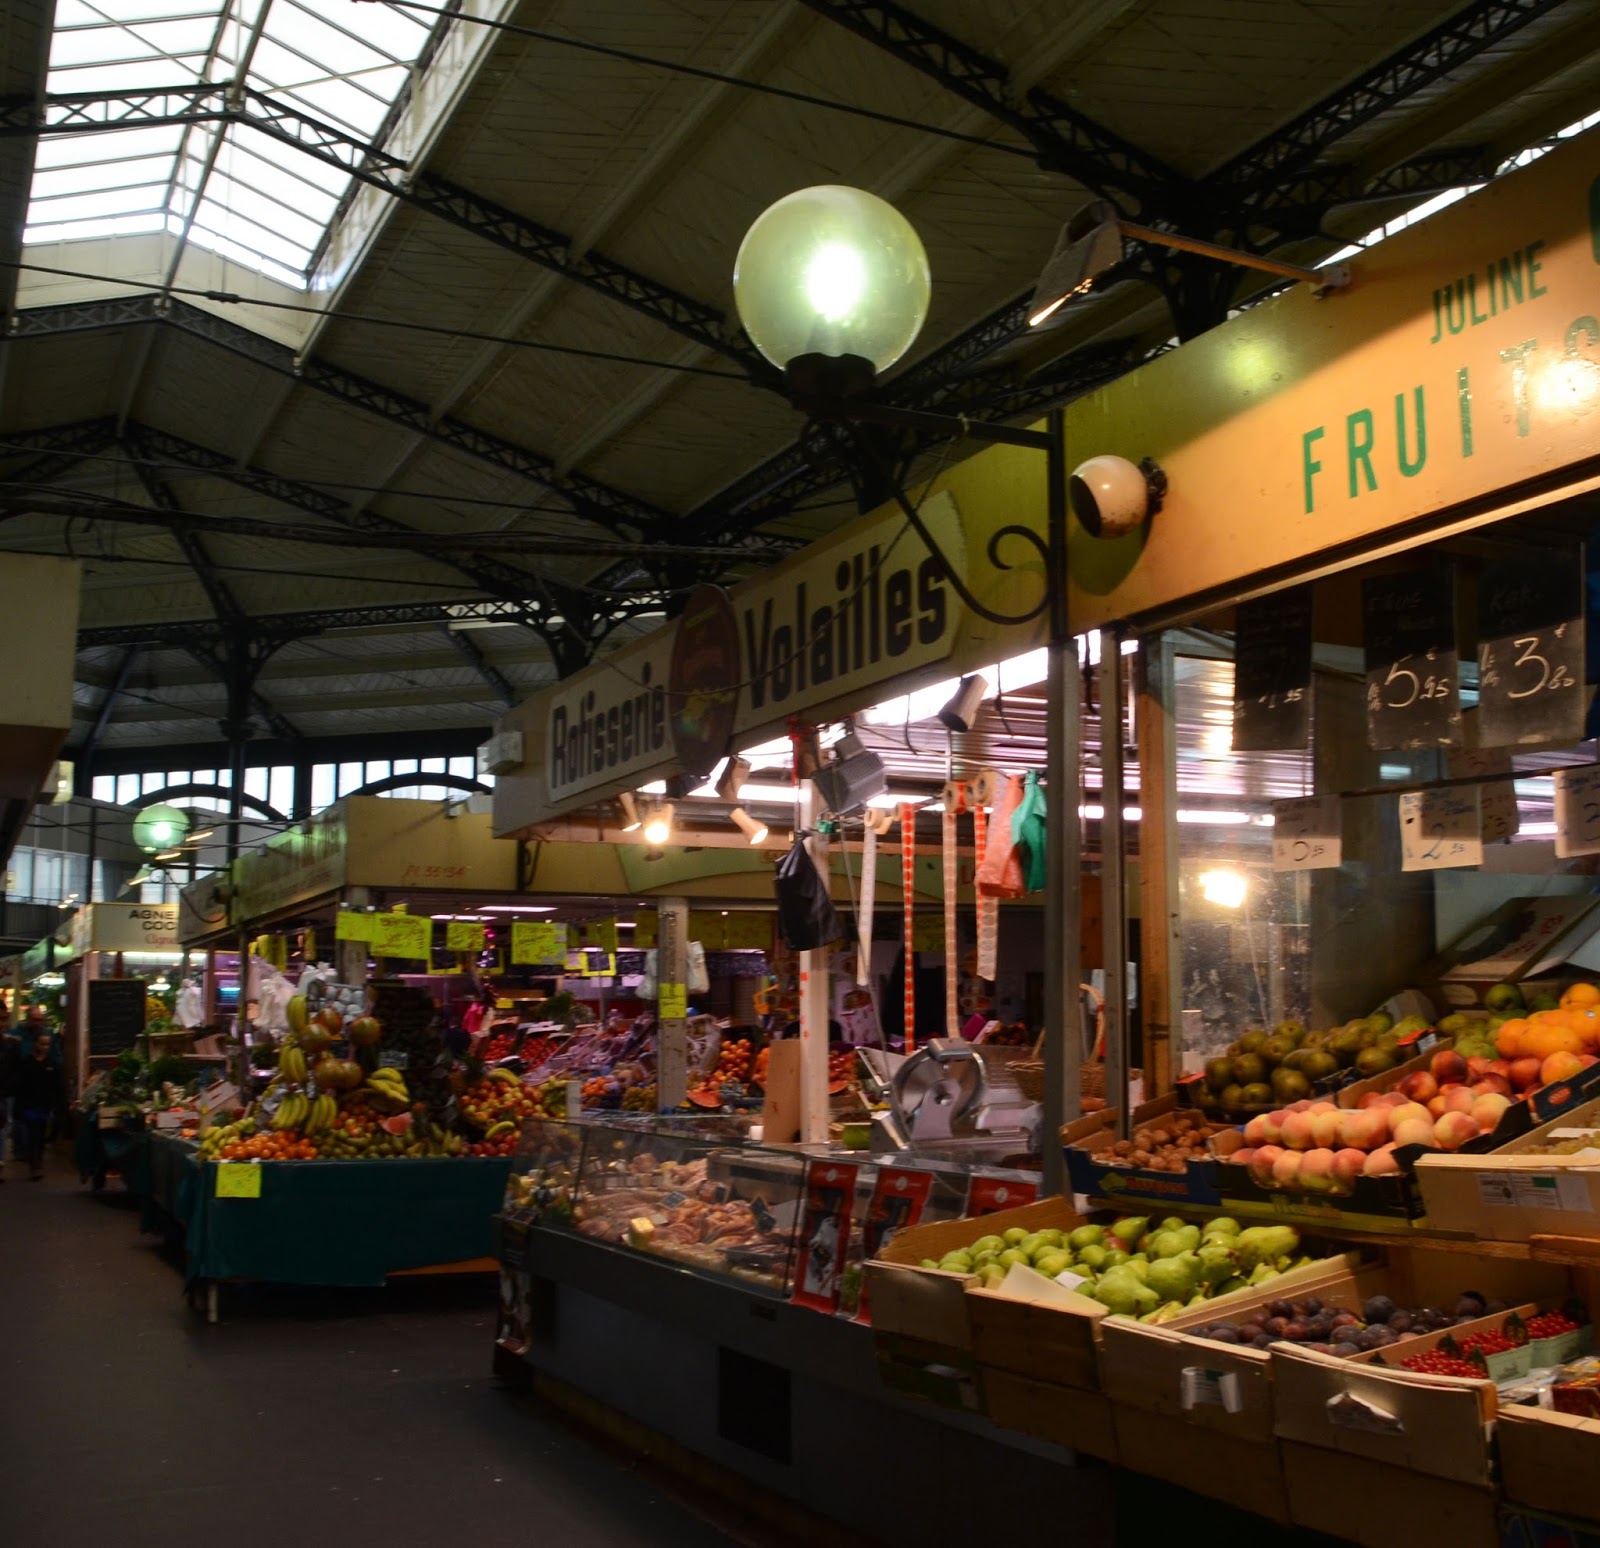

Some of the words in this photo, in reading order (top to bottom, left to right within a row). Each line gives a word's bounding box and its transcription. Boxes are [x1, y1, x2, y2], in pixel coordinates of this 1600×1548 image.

[1431, 240, 1547, 344] JULINE
[745, 545, 946, 709] Volailles
[552, 661, 664, 788] Rotisserie
